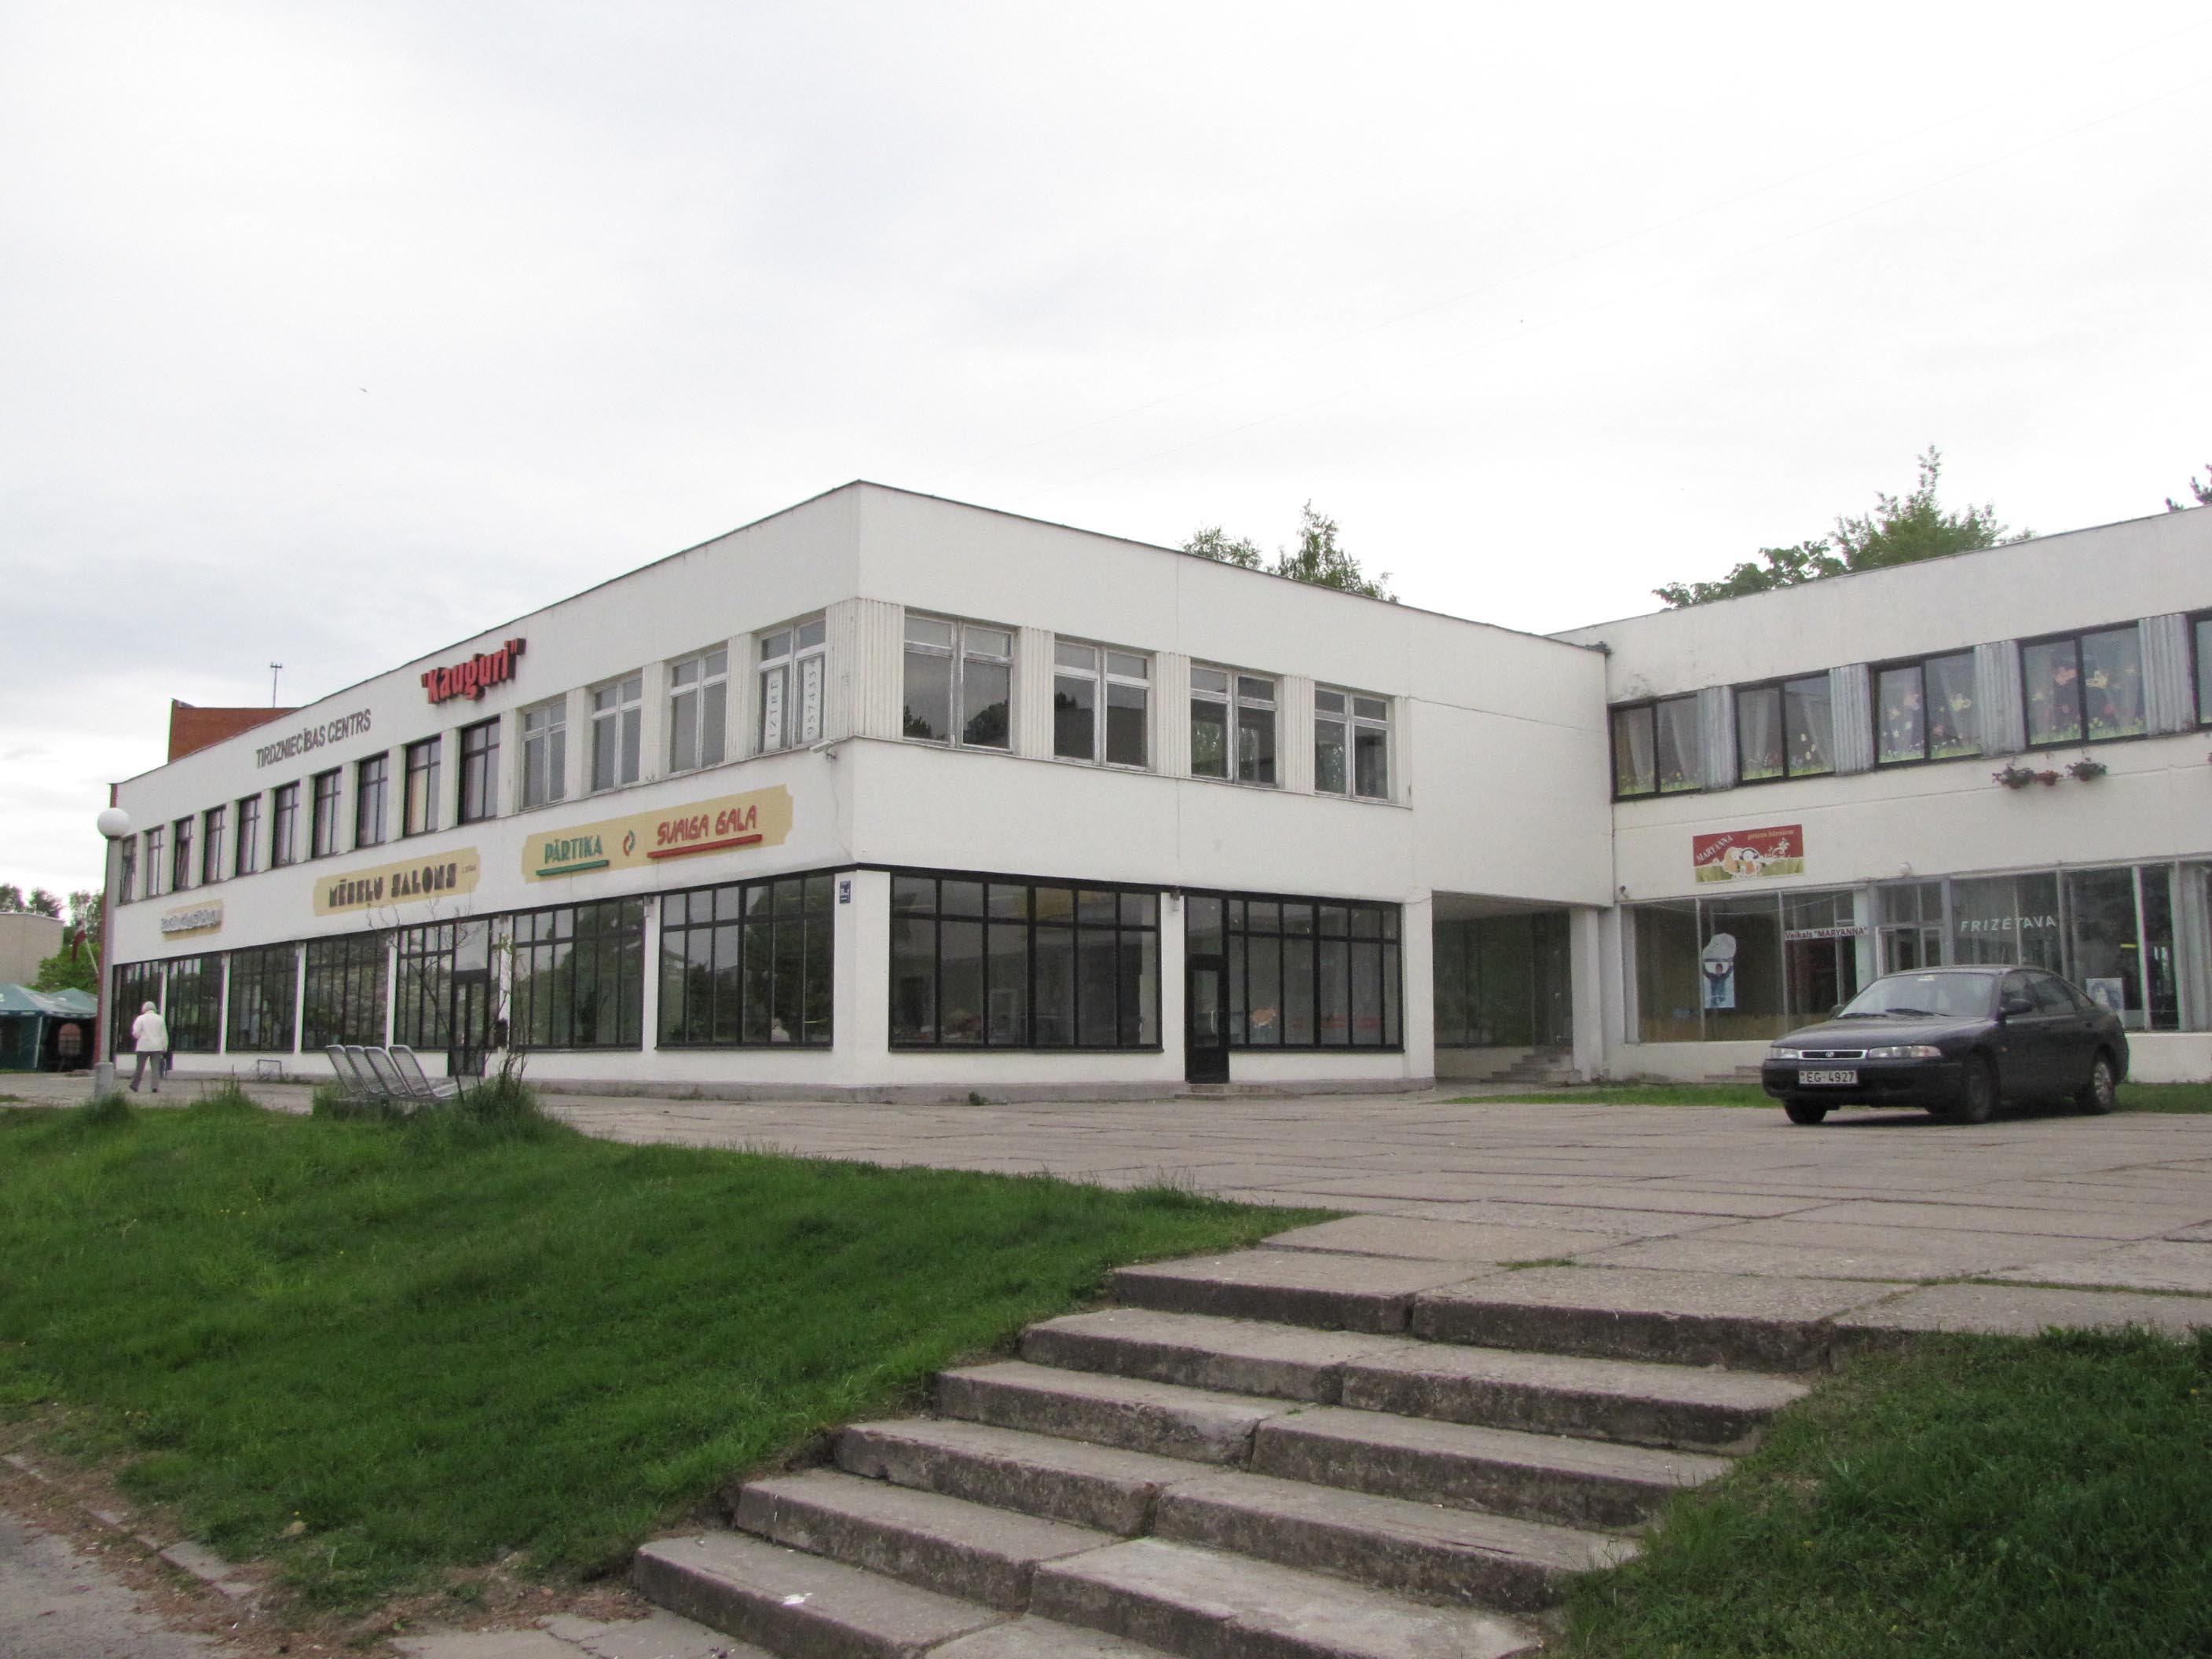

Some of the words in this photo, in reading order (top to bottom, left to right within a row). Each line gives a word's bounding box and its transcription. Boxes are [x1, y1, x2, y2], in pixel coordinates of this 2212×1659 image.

[256, 725, 325, 769] TIRDZNIECĪBAS
[328, 709, 371, 743] CENTRS
[657, 814, 709, 845] SVAIGA
[716, 804, 756, 835] GALA
[545, 835, 602, 863] PĀRTIKA
[1697, 835, 1734, 862] MARYANNA
[391, 862, 457, 898] SALONS
[1785, 931, 1812, 939] Veikals
